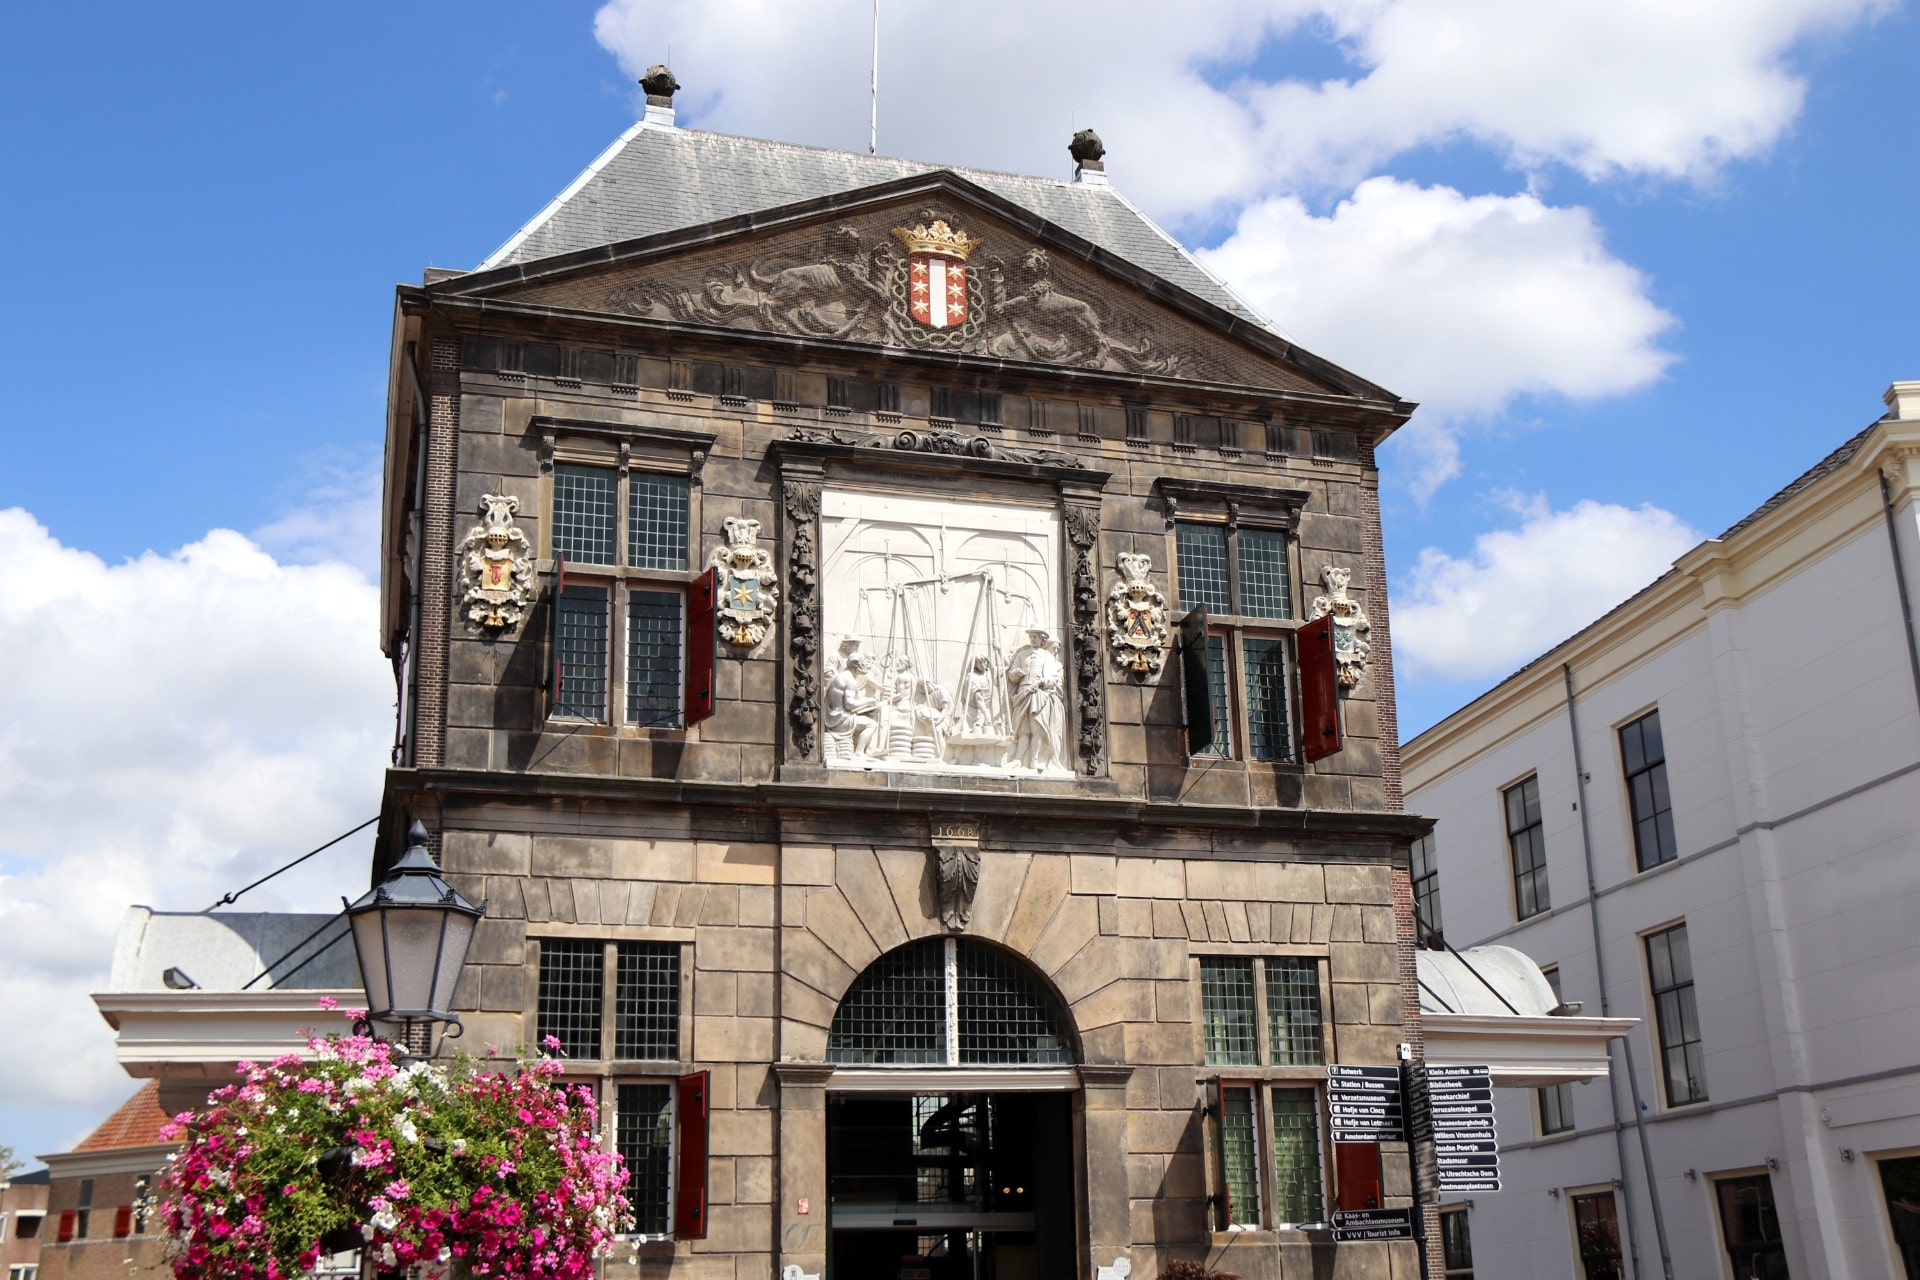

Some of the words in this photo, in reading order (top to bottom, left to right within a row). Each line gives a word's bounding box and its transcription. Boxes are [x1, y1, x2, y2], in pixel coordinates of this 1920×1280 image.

[938, 825, 973, 837] 1668
[1429, 1068, 1444, 1076] Klein
[1341, 1080, 1361, 1088] Station
[1365, 1081, 1385, 1089] Bussen
[1341, 1094, 1386, 1102] Verzetsmuseum
[1430, 1092, 1470, 1100] Streekarchief
[1342, 1106, 1358, 1114] Hofje
[1369, 1107, 1386, 1116] Cincq
[1432, 1105, 1478, 1114] Jeruzalemkapel
[1343, 1119, 1359, 1127] Hofje
[1434, 1131, 1456, 1139] Willem
[1455, 1131, 1492, 1139] Vroesenhuis
[1456, 1144, 1479, 1152] Poortje
[1345, 1217, 1405, 1226] Ambachtenmuseum
[1346, 1231, 1362, 1239] VVV
